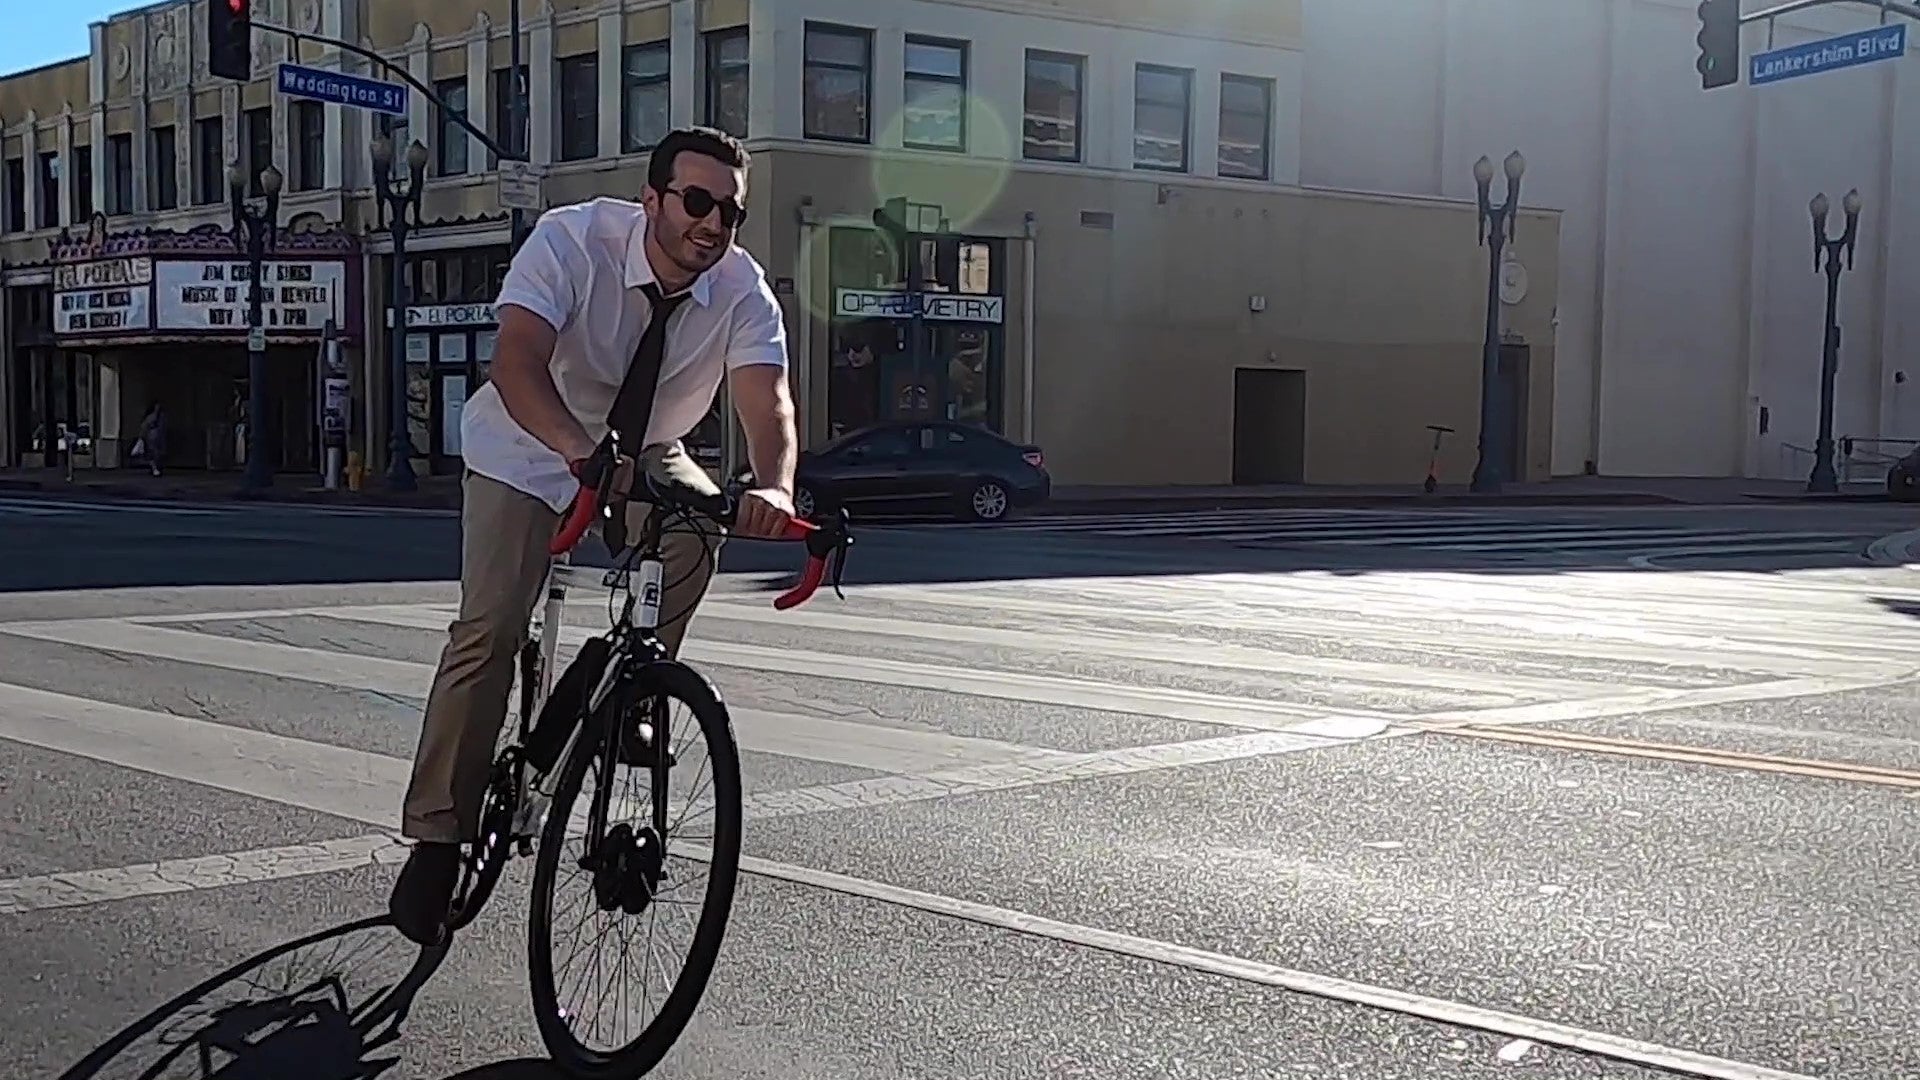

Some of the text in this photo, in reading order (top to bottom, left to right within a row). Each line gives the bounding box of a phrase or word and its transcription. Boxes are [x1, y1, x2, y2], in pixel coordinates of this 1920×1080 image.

[1753, 32, 1900, 78] Lankershim Blvd
[283, 70, 400, 107] Weddington St
[182, 286, 218, 303] MUSIC
[244, 286, 275, 303] JHN
[446, 306, 496, 322] PORTA
